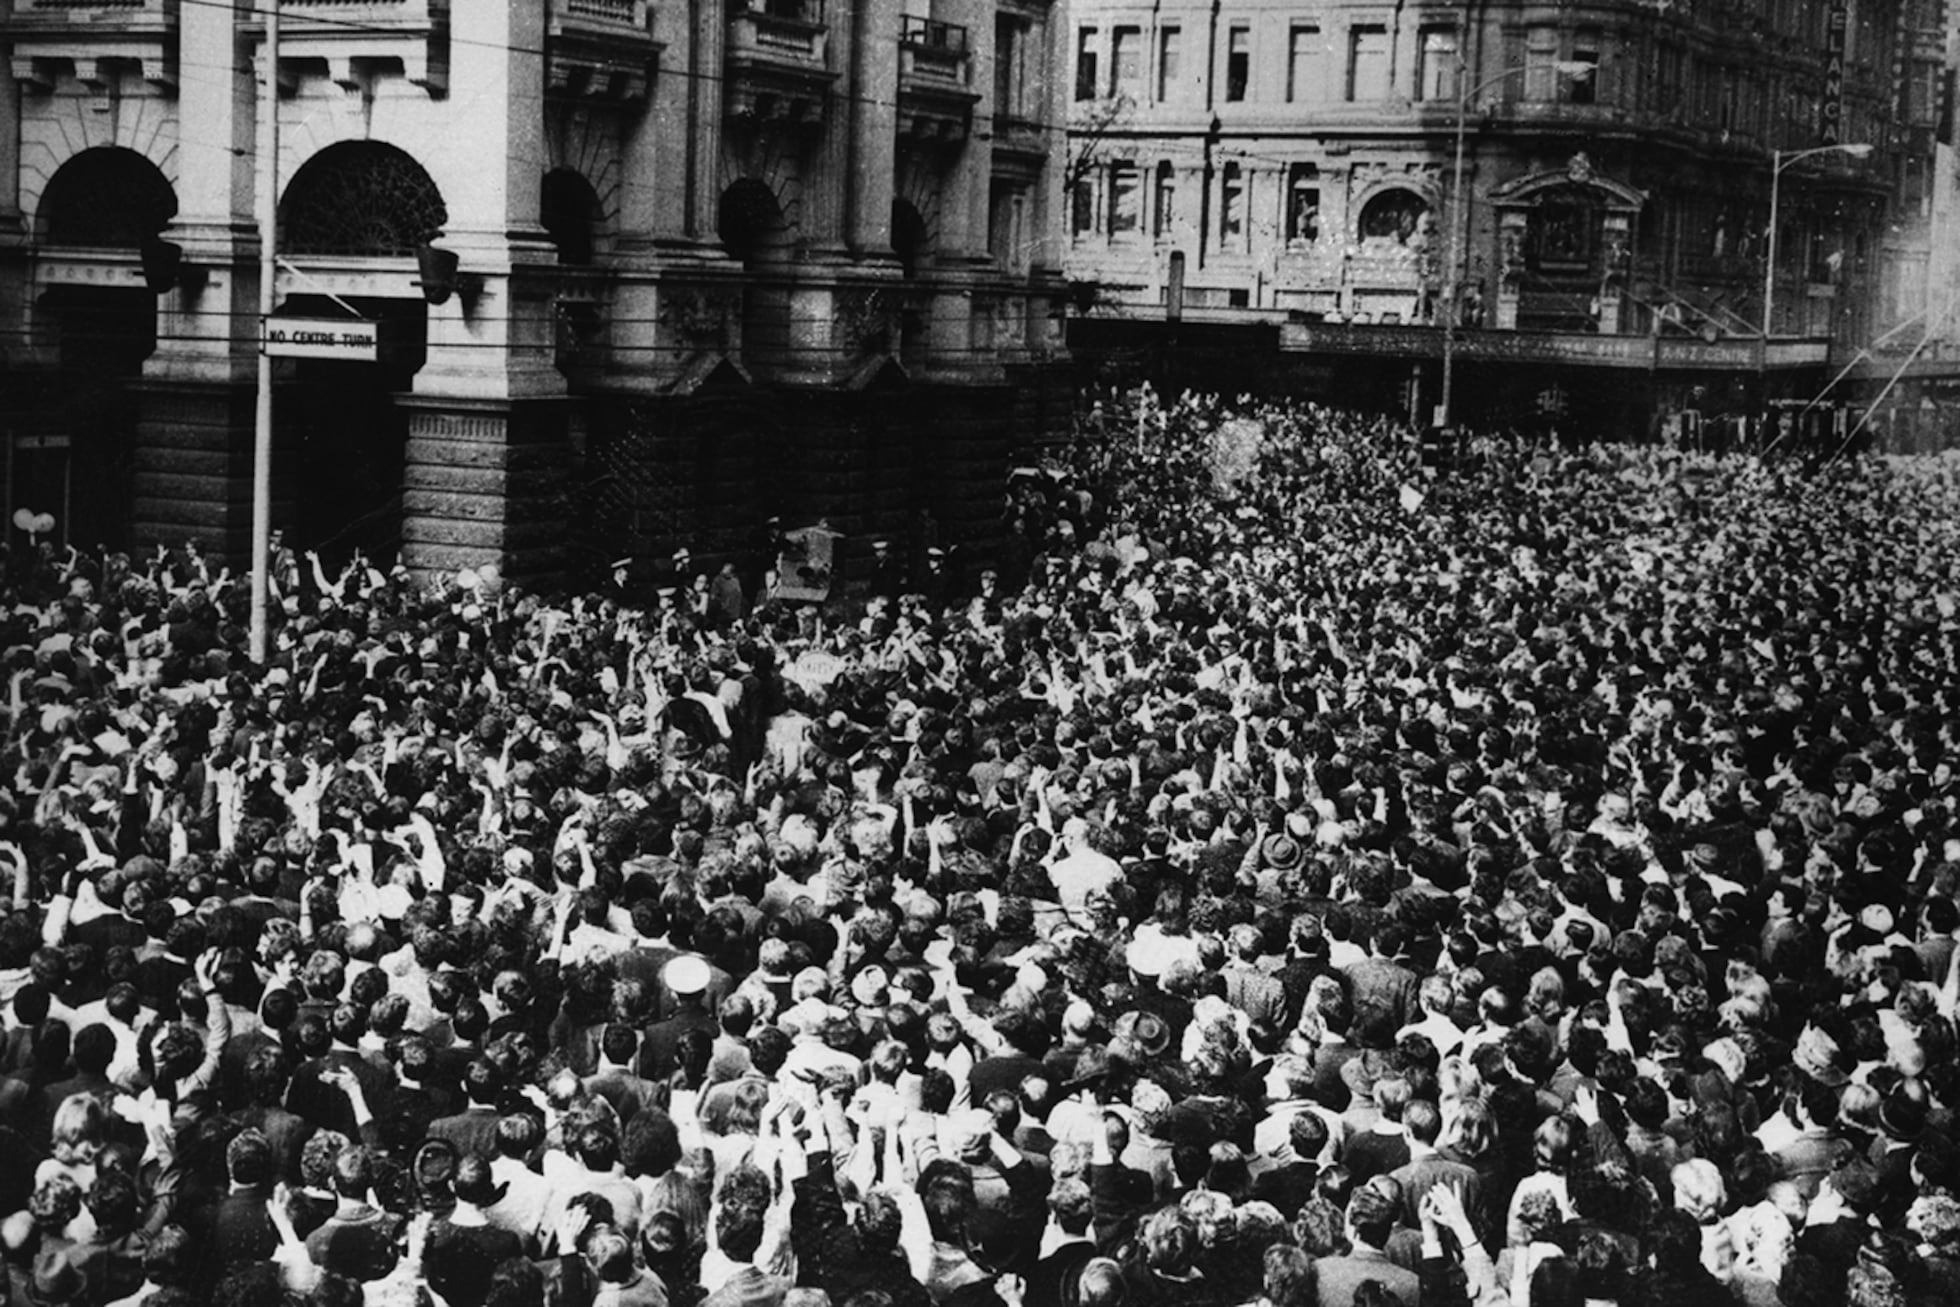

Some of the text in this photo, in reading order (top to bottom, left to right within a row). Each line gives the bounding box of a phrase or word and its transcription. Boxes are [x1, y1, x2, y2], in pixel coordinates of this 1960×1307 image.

[270, 330, 373, 349] NO CENTRE TURN
[1703, 347, 1751, 364] CENTRE
